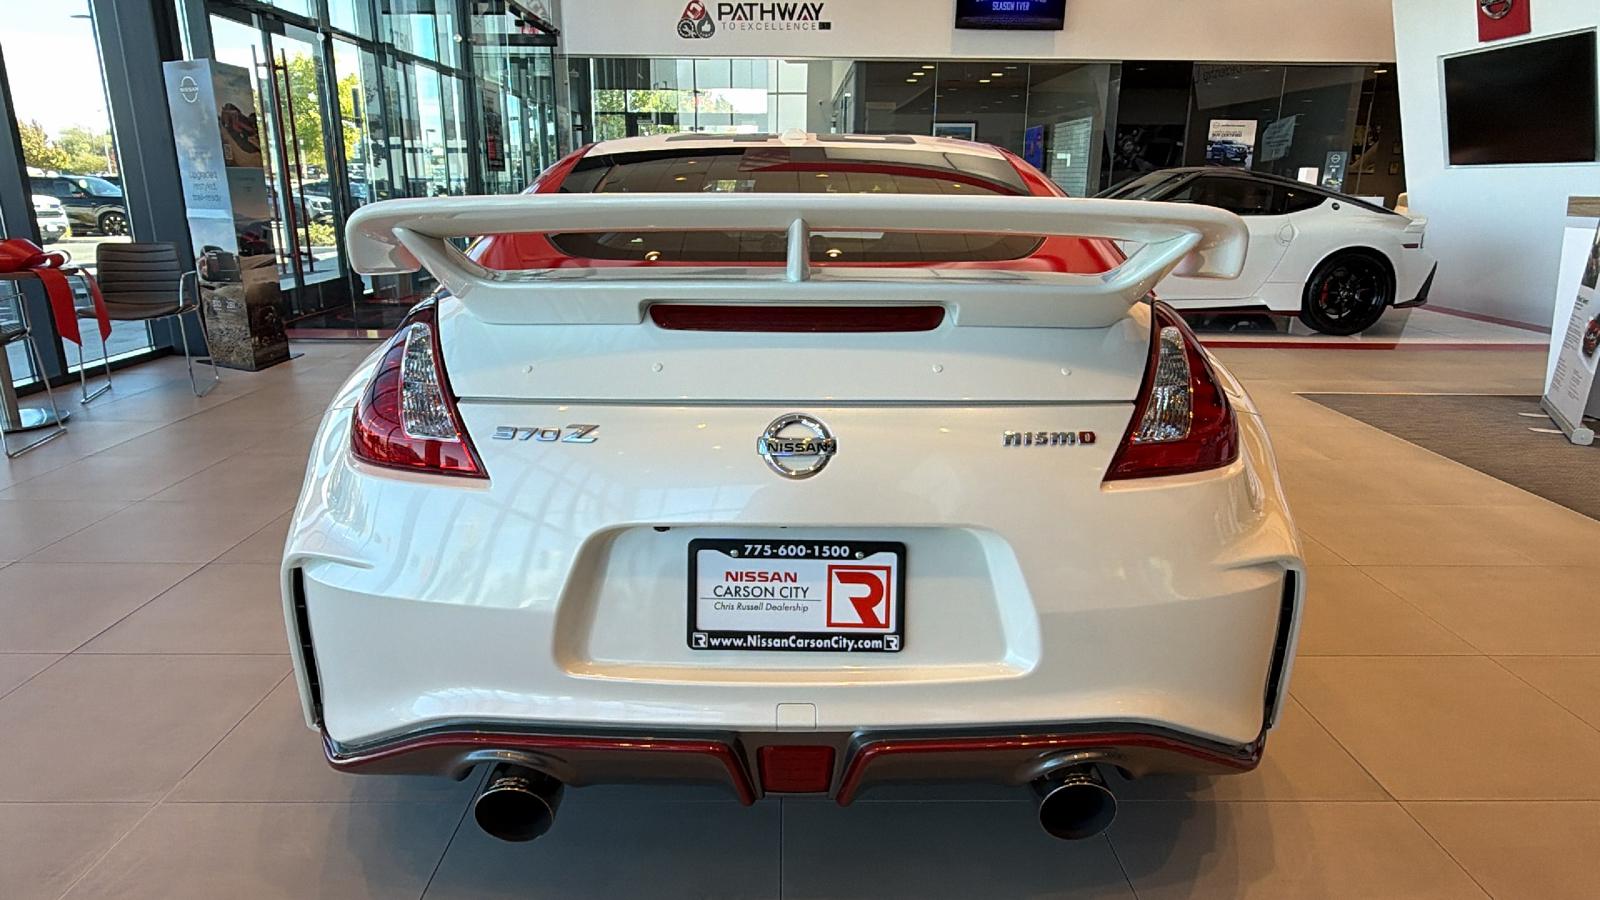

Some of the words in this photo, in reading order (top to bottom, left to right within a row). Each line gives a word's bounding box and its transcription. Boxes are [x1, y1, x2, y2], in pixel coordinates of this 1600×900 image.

[717, 2, 824, 21] PATHWAY
[992, 1, 1014, 11] SEASON
[1016, 1, 1030, 11] EVER
[722, 22, 735, 31] TO
[740, 22, 817, 31] EXCELLENCE
[767, 442, 828, 453] NISSAN
[744, 544, 850, 558] 775-600-1500
[724, 571, 798, 583] NISSAN
[713, 585, 775, 598] CARSON
[779, 586, 810, 599] CITY
[713, 601, 734, 611] Chris
[736, 602, 764, 612] Russell
[765, 602, 809, 614] Dealership
[710, 634, 883, 651] www.NissanCarsonCity.com
